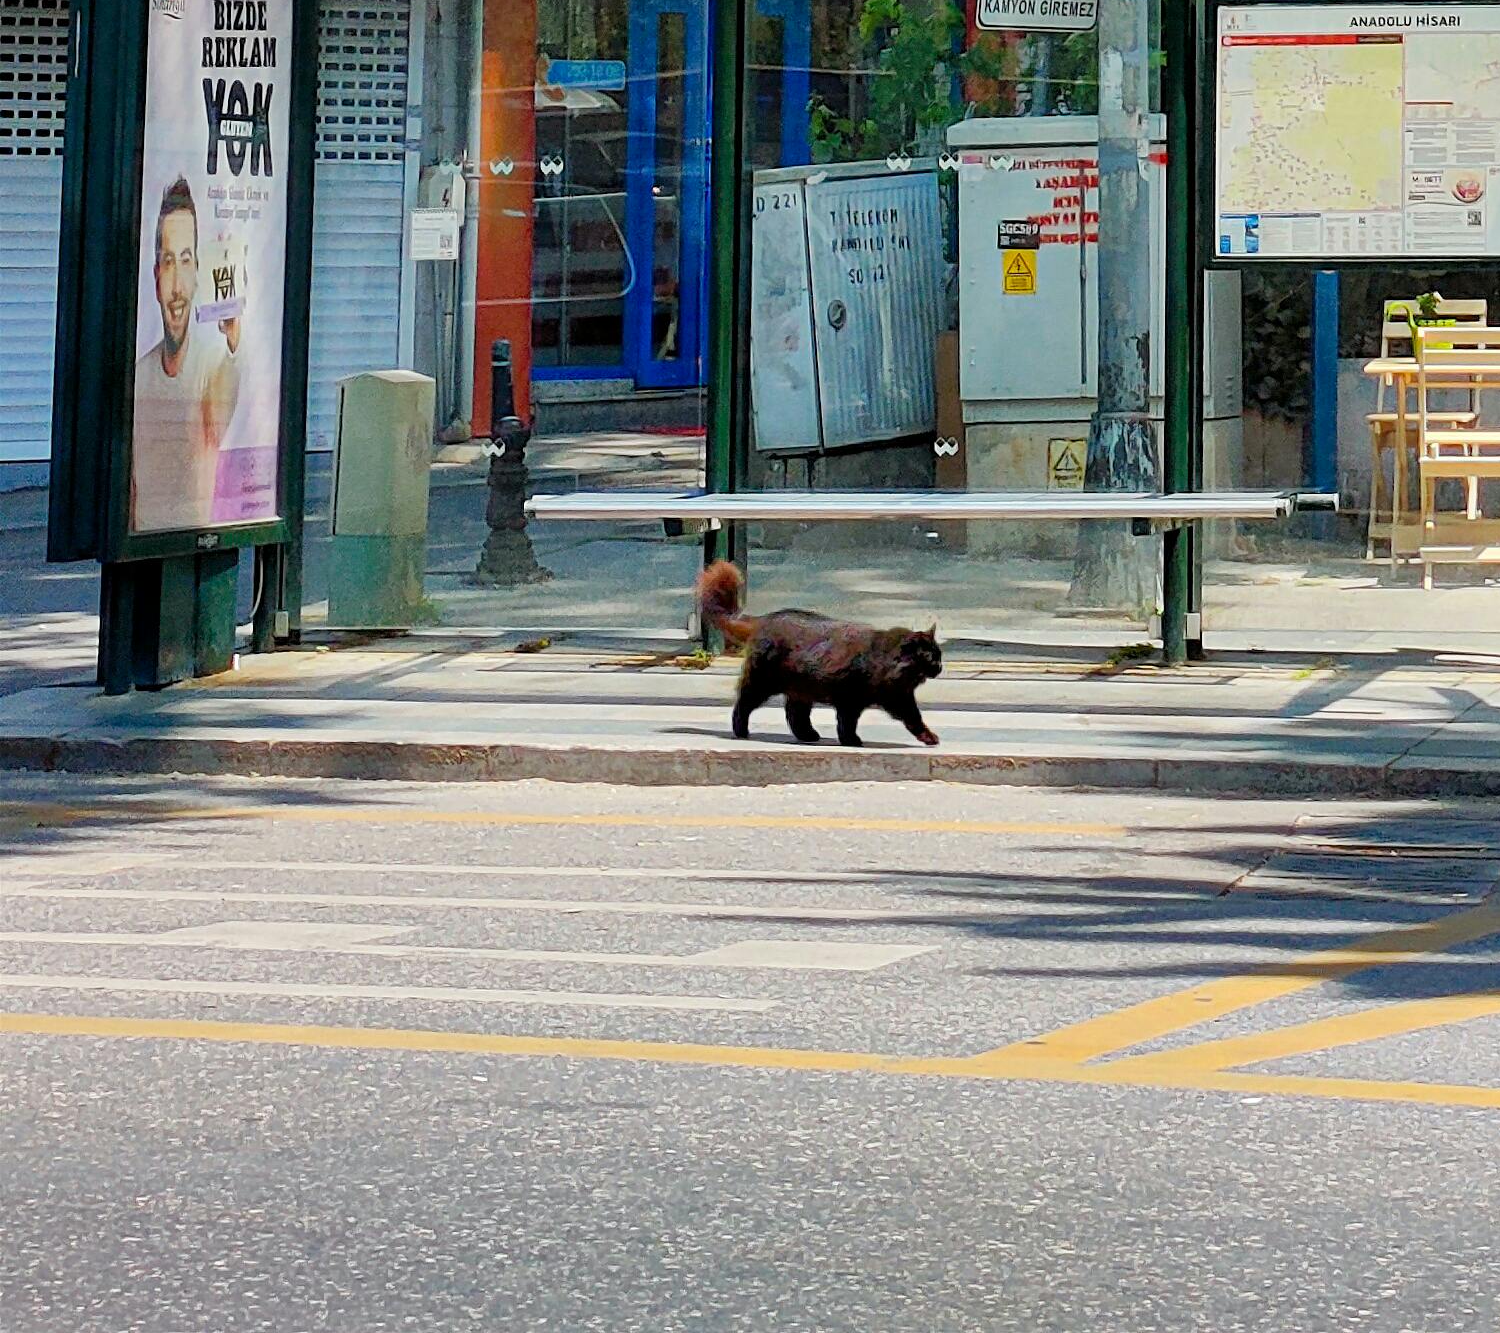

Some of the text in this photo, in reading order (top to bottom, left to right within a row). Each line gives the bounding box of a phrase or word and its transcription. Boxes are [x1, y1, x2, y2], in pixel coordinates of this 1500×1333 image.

[1348, 12, 1462, 29] ANADOLU HİSARI
[201, 36, 277, 68] REKLAM
[202, 77, 274, 177] YOK
